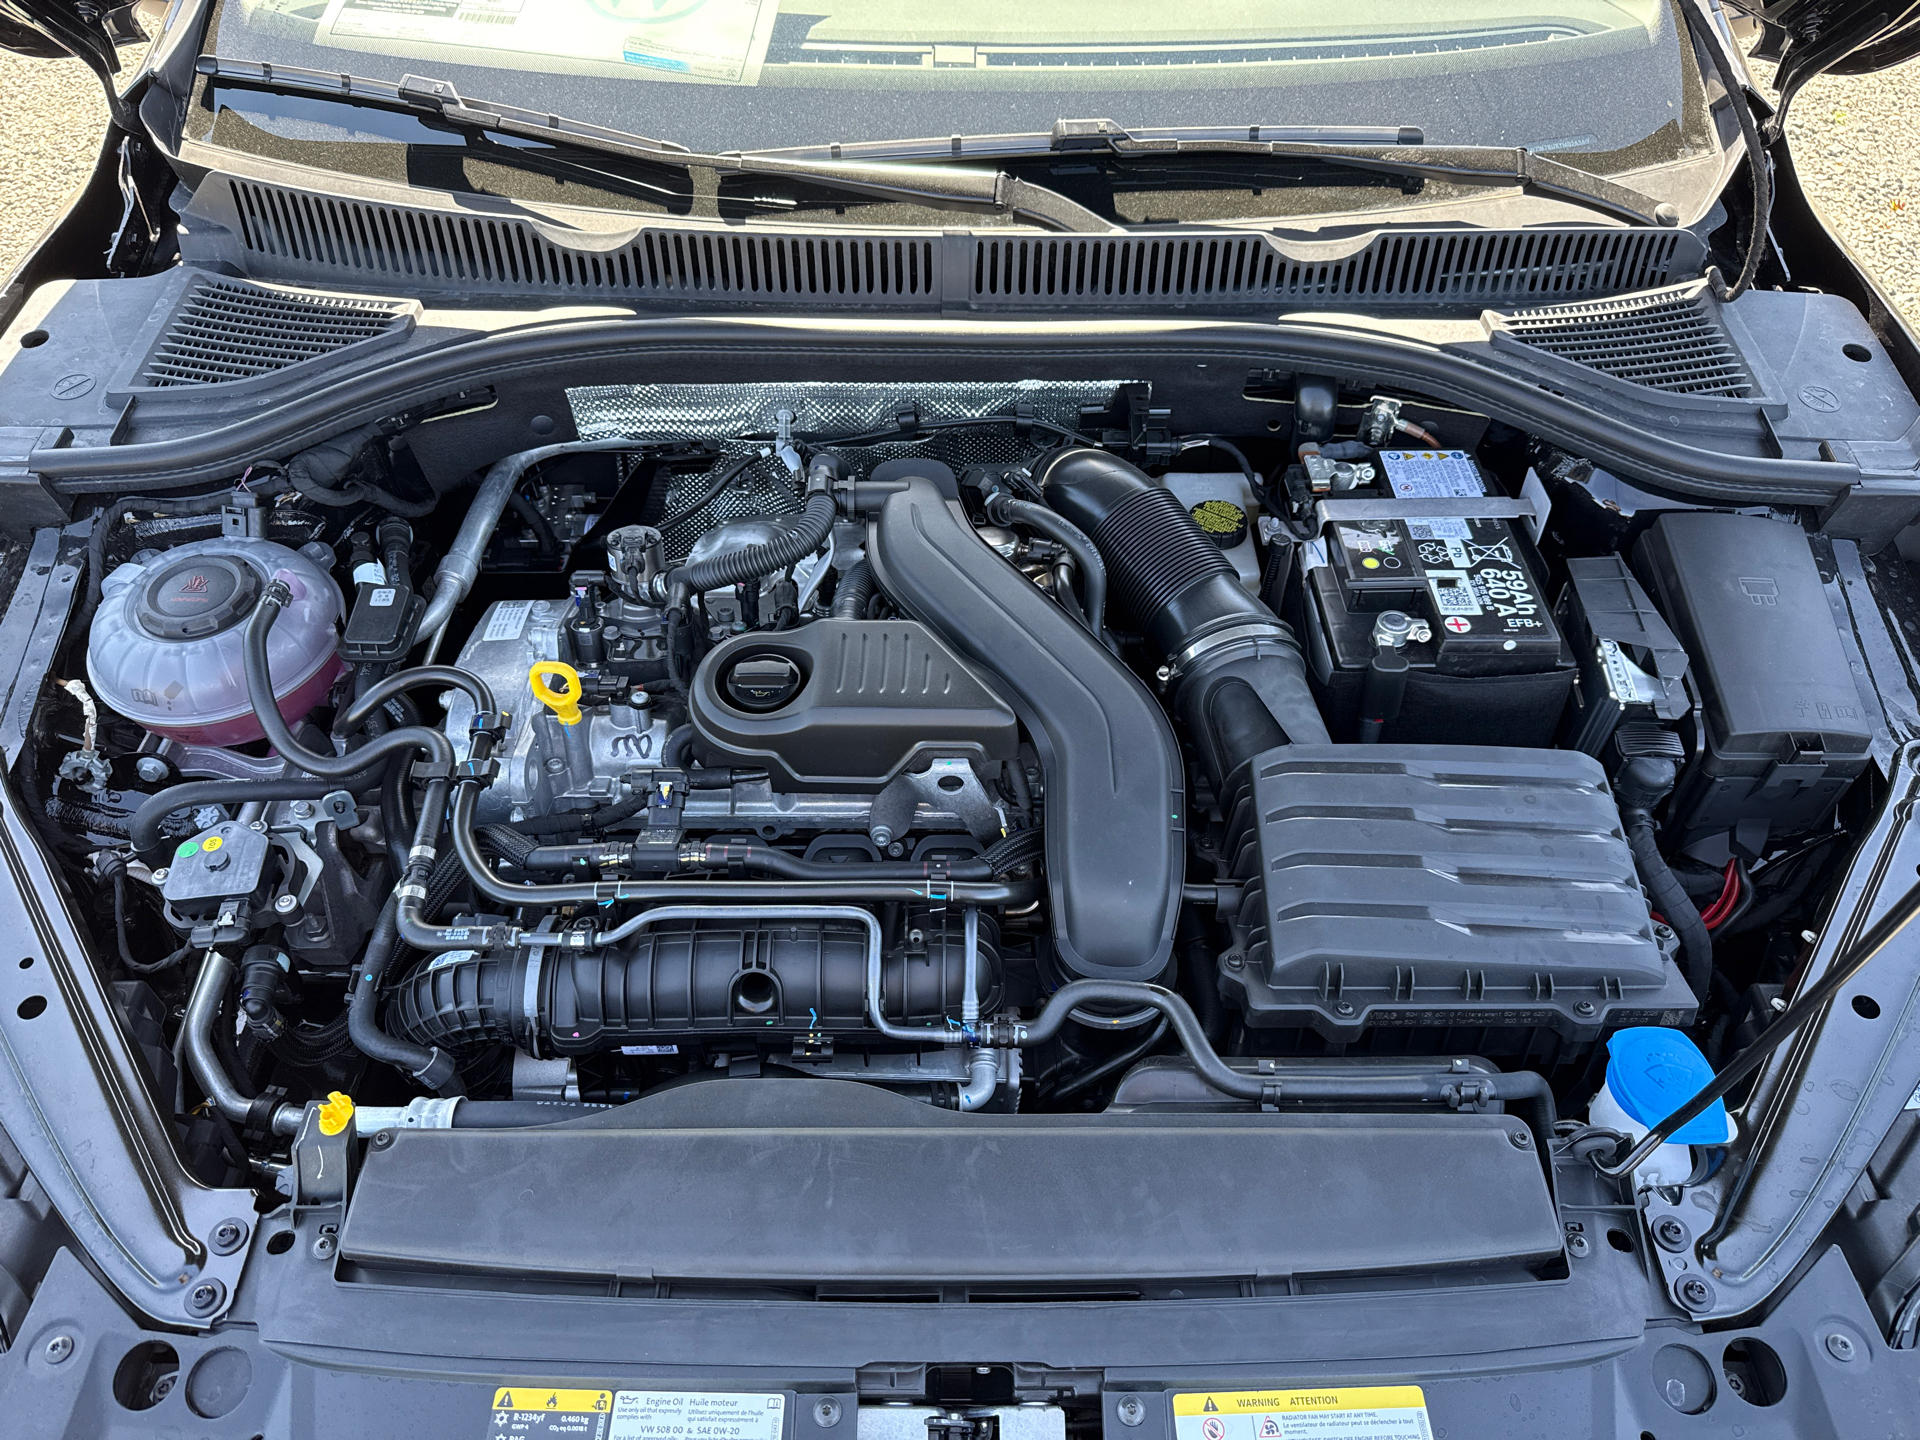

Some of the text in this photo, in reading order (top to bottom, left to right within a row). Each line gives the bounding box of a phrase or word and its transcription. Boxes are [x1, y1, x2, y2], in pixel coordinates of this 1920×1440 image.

[1451, 547, 1462, 558] Pb
[1480, 568, 1510, 599] 640
[1502, 570, 1538, 615] 59Ah
[1494, 603, 1518, 617] A
[1507, 619, 1543, 628] EFB+
[646, 1398, 671, 1407] Engine
[1236, 1396, 1338, 1407] WARNING ATTENTION
[513, 1413, 546, 1424] R-1234yf
[581, 1416, 589, 1425] kg
